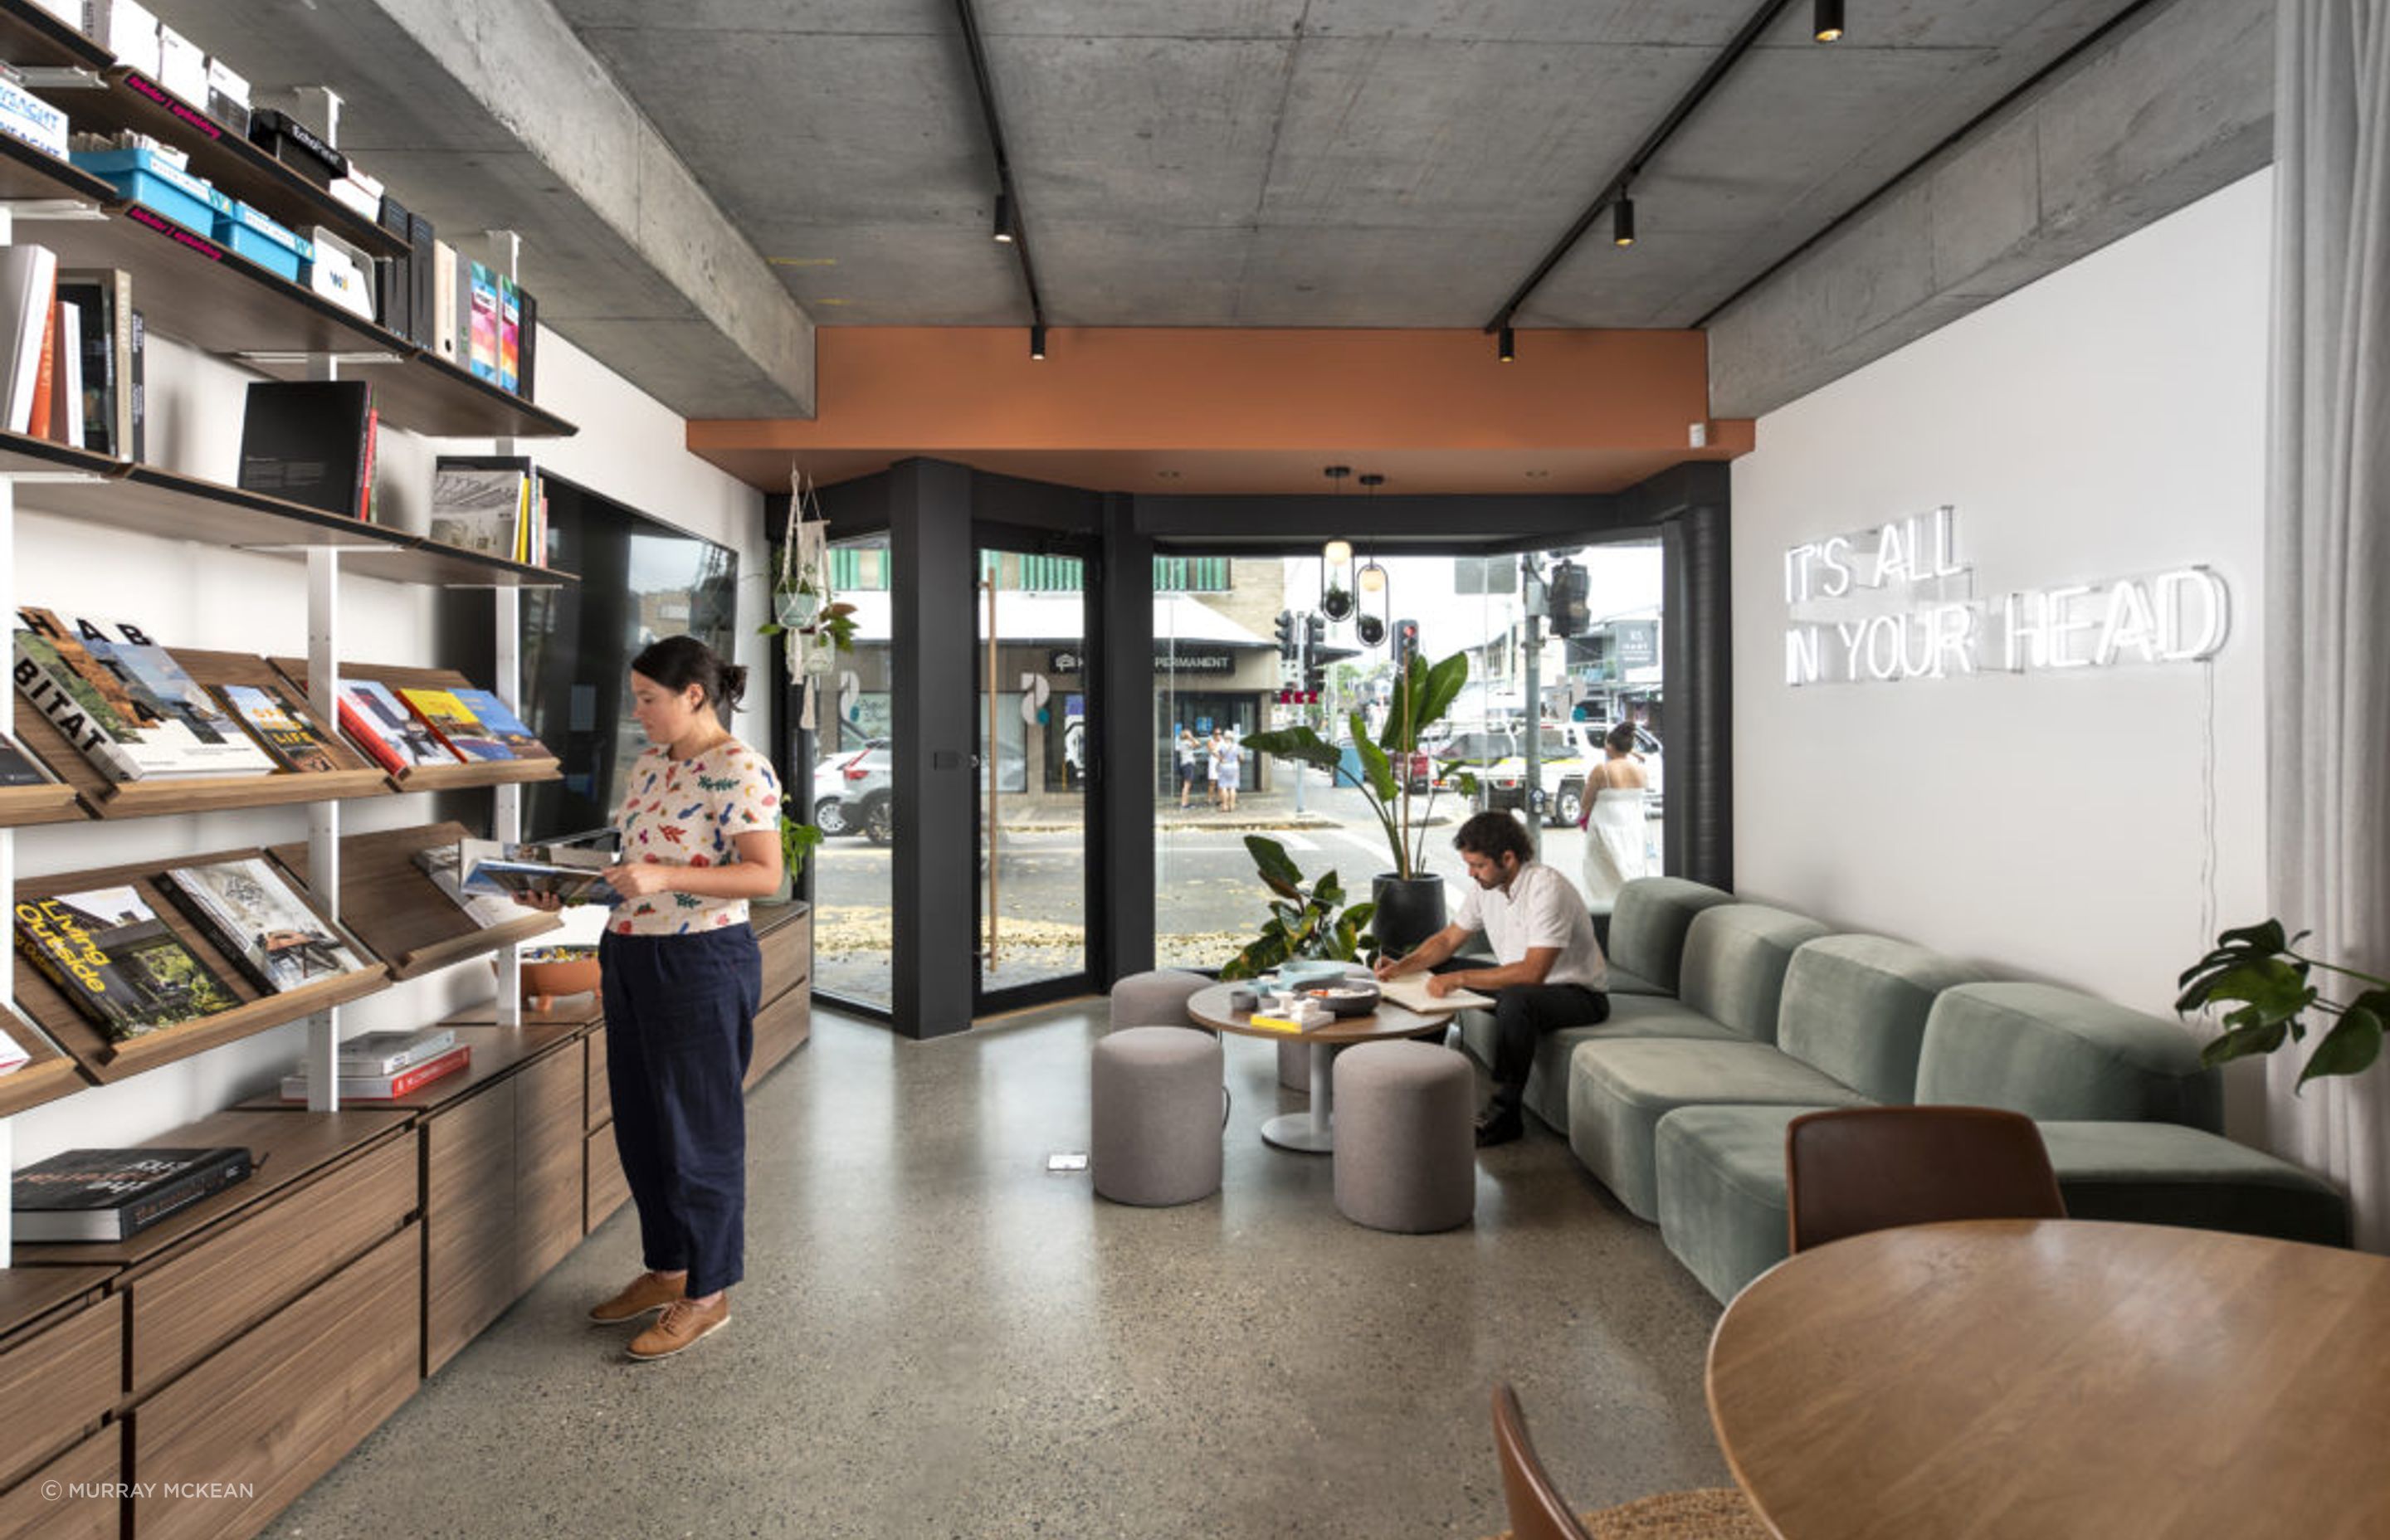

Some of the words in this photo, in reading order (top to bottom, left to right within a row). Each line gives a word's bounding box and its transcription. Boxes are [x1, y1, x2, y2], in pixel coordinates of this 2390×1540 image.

[1786, 537, 1850, 603] IT'S
[1873, 509, 1963, 587] ALL
[1786, 624, 1819, 683] IN
[1837, 604, 1972, 680] YOUR
[2005, 568, 2217, 670] HEAD
[13, 657, 108, 752] BITAT
[15, 904, 105, 992] Outside
[38, 899, 111, 967] Living
